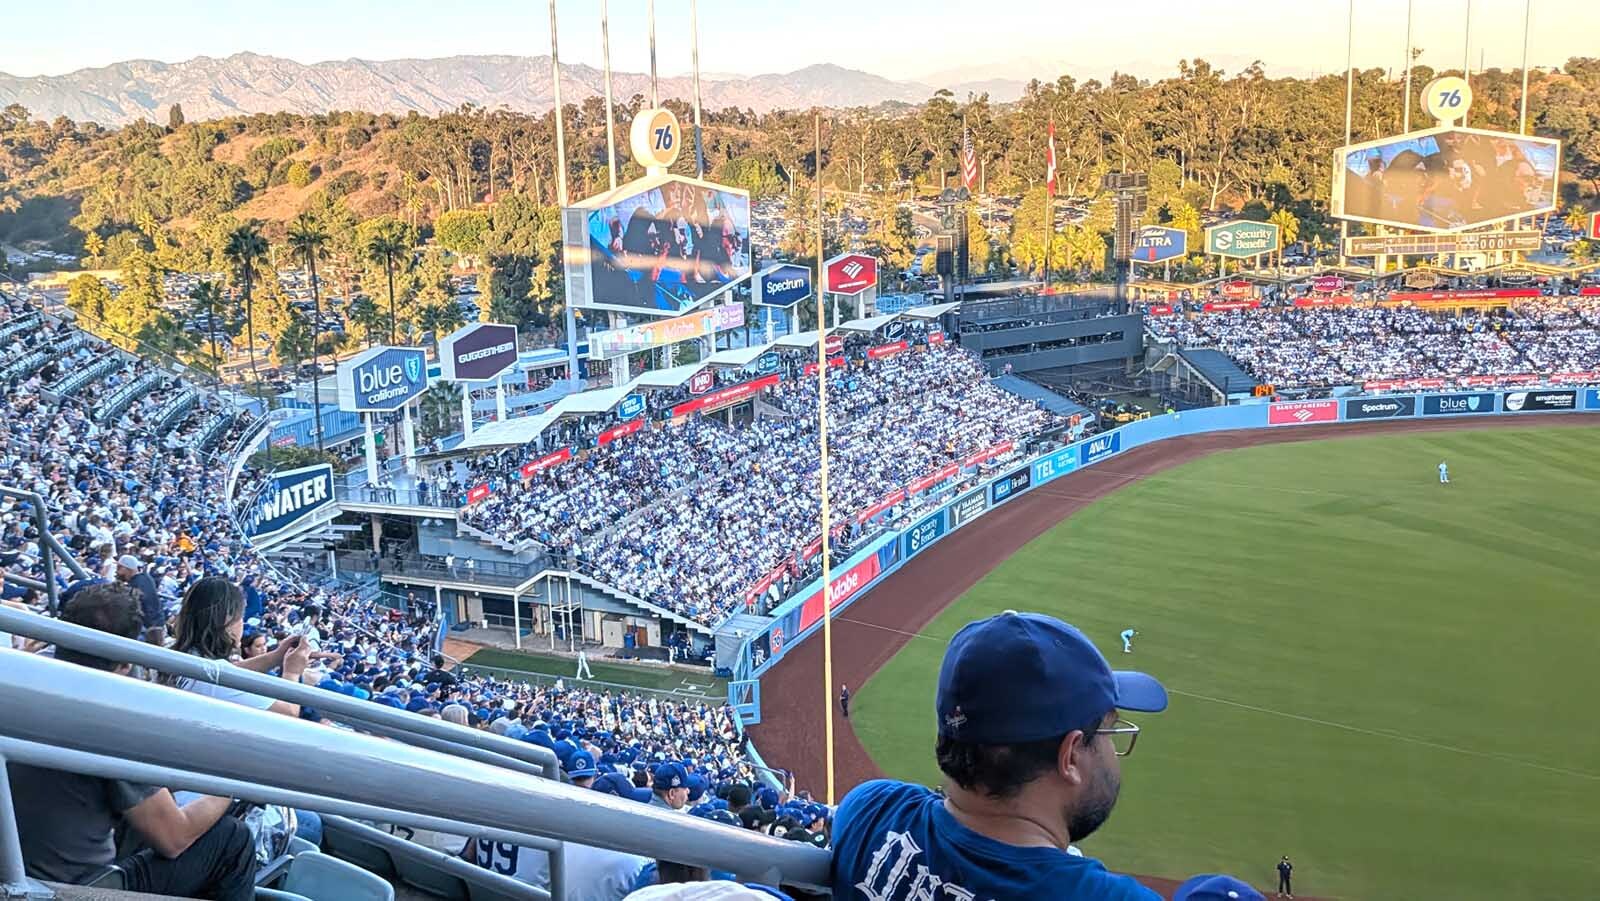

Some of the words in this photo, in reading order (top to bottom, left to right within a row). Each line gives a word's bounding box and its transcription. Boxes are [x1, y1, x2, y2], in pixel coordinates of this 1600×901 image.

[1439, 89, 1461, 107] 76
[655, 125, 673, 151] 76
[1235, 230, 1272, 240] Security
[1235, 240, 1268, 249] Benefit
[767, 278, 803, 296] Spectrum
[458, 342, 513, 364] GUGGENHEIM
[359, 364, 403, 393] blue
[368, 384, 408, 404] california
[1440, 398, 1468, 408] blue
[1535, 394, 1574, 402] smartwater
[1362, 404, 1398, 413] Spectrum
[1088, 438, 1105, 456] ANA
[1036, 460, 1056, 481] TEL
[829, 572, 858, 604] Adobe
[477, 836, 520, 876] 99
